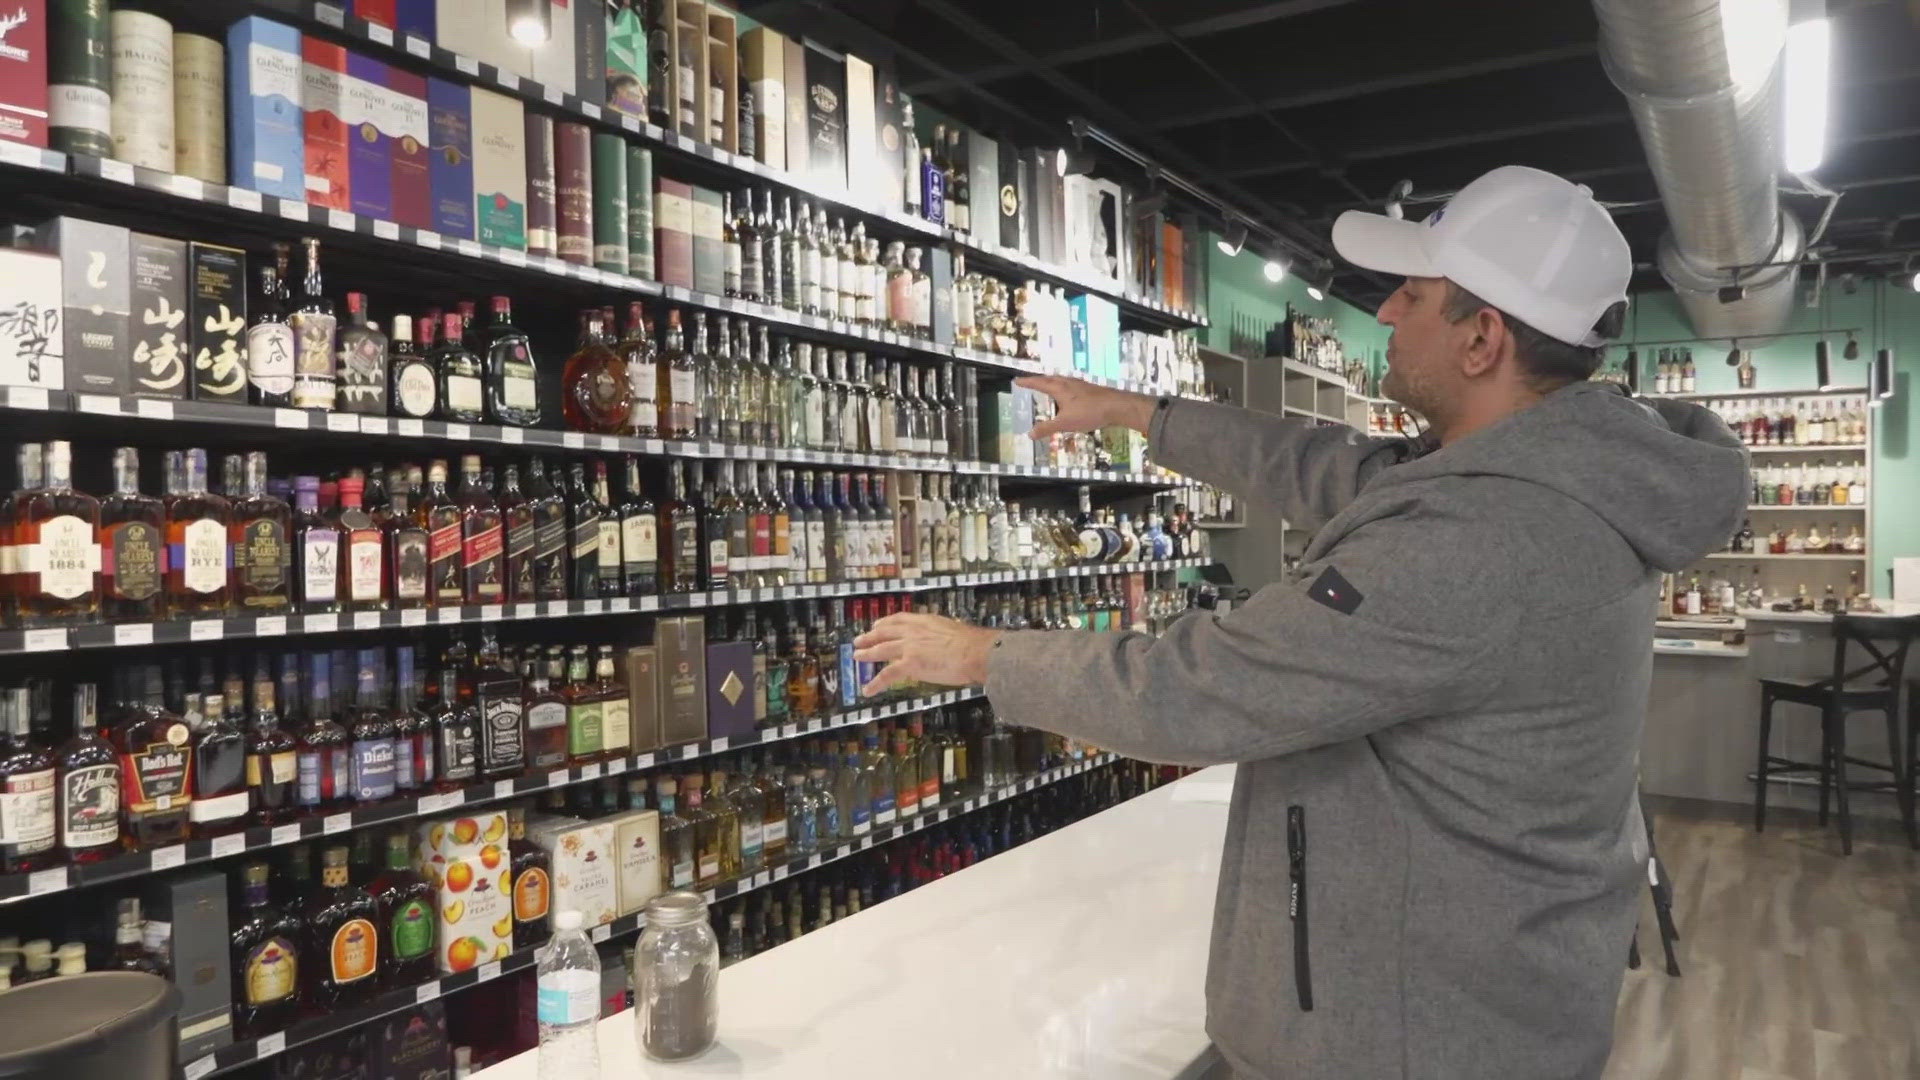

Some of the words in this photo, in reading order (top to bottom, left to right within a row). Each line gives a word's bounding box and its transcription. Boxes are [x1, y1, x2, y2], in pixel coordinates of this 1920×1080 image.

[49, 560, 86, 570] 1884
[191, 557, 222, 567] RYE
[166, 752, 183, 767] Hat
[624, 855, 656, 870] VANILLA
[573, 877, 609, 893] CARAMEL
[469, 902, 496, 915] PEACH
